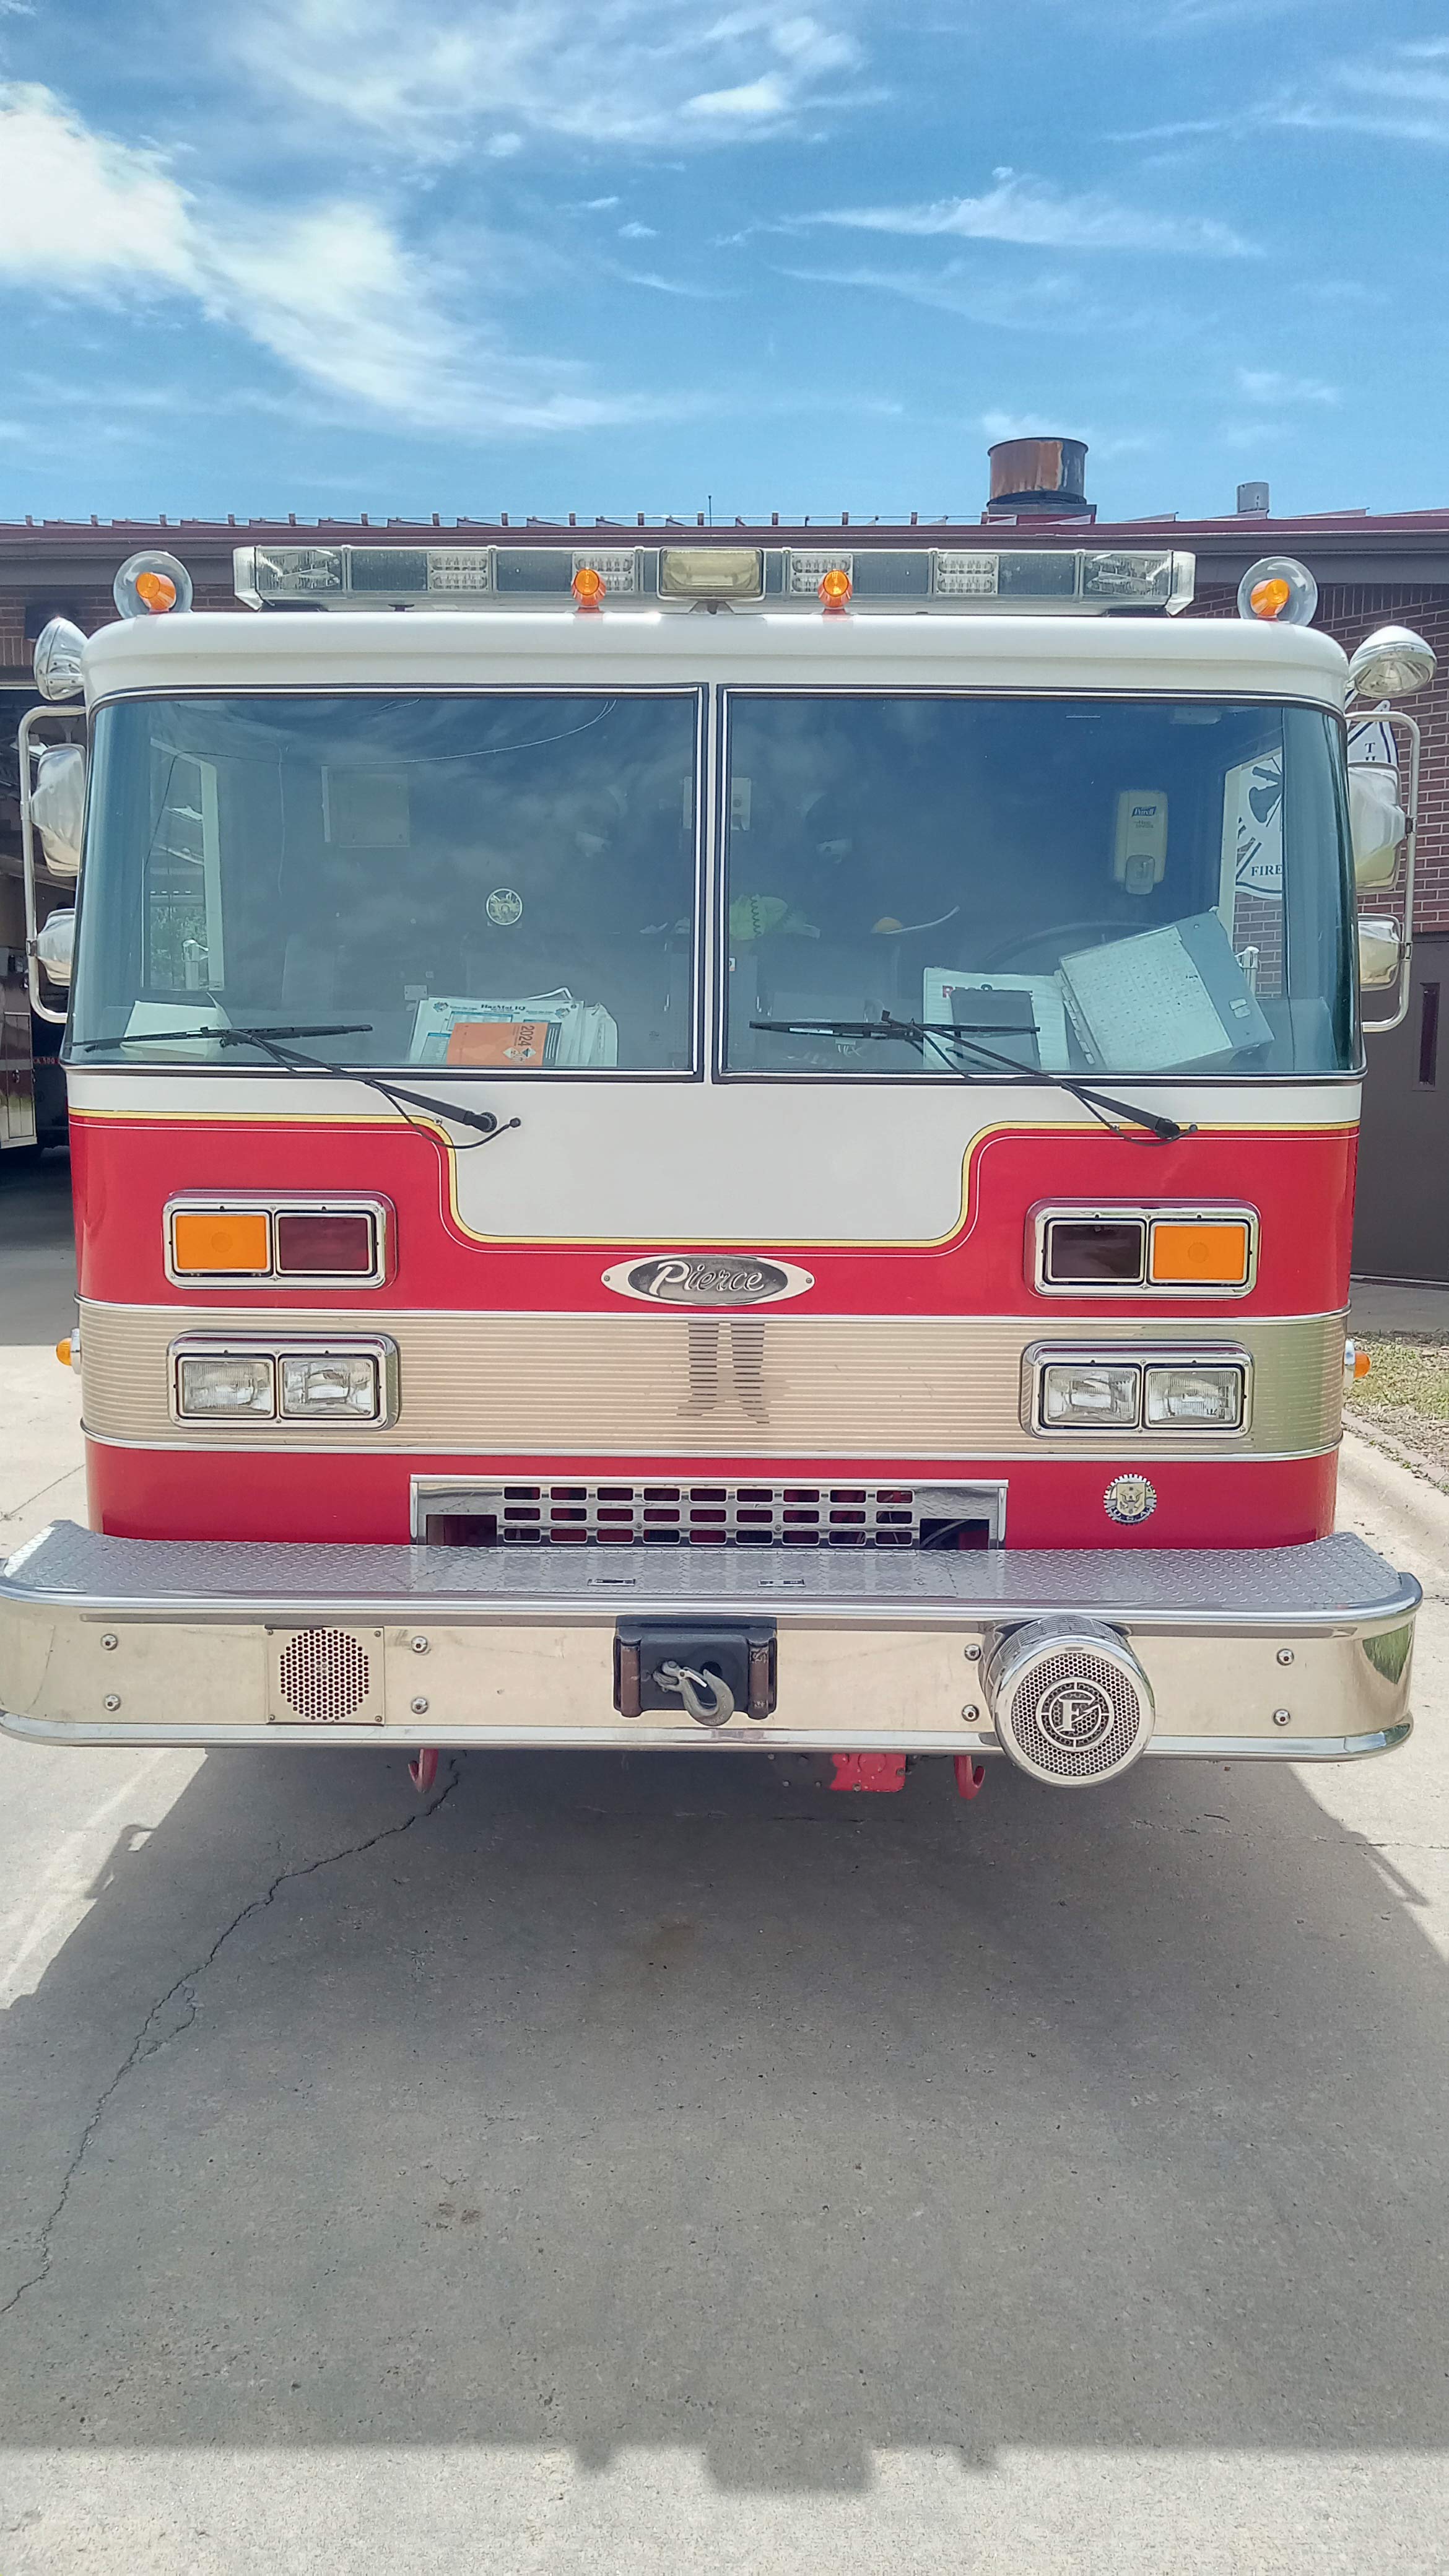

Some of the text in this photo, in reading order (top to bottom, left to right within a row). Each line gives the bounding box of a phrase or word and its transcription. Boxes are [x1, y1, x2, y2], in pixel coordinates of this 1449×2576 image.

[1251, 864, 1283, 876] FIRE
[518, 1025, 535, 1046] 2024
[648, 1260, 764, 1296] Pierce
